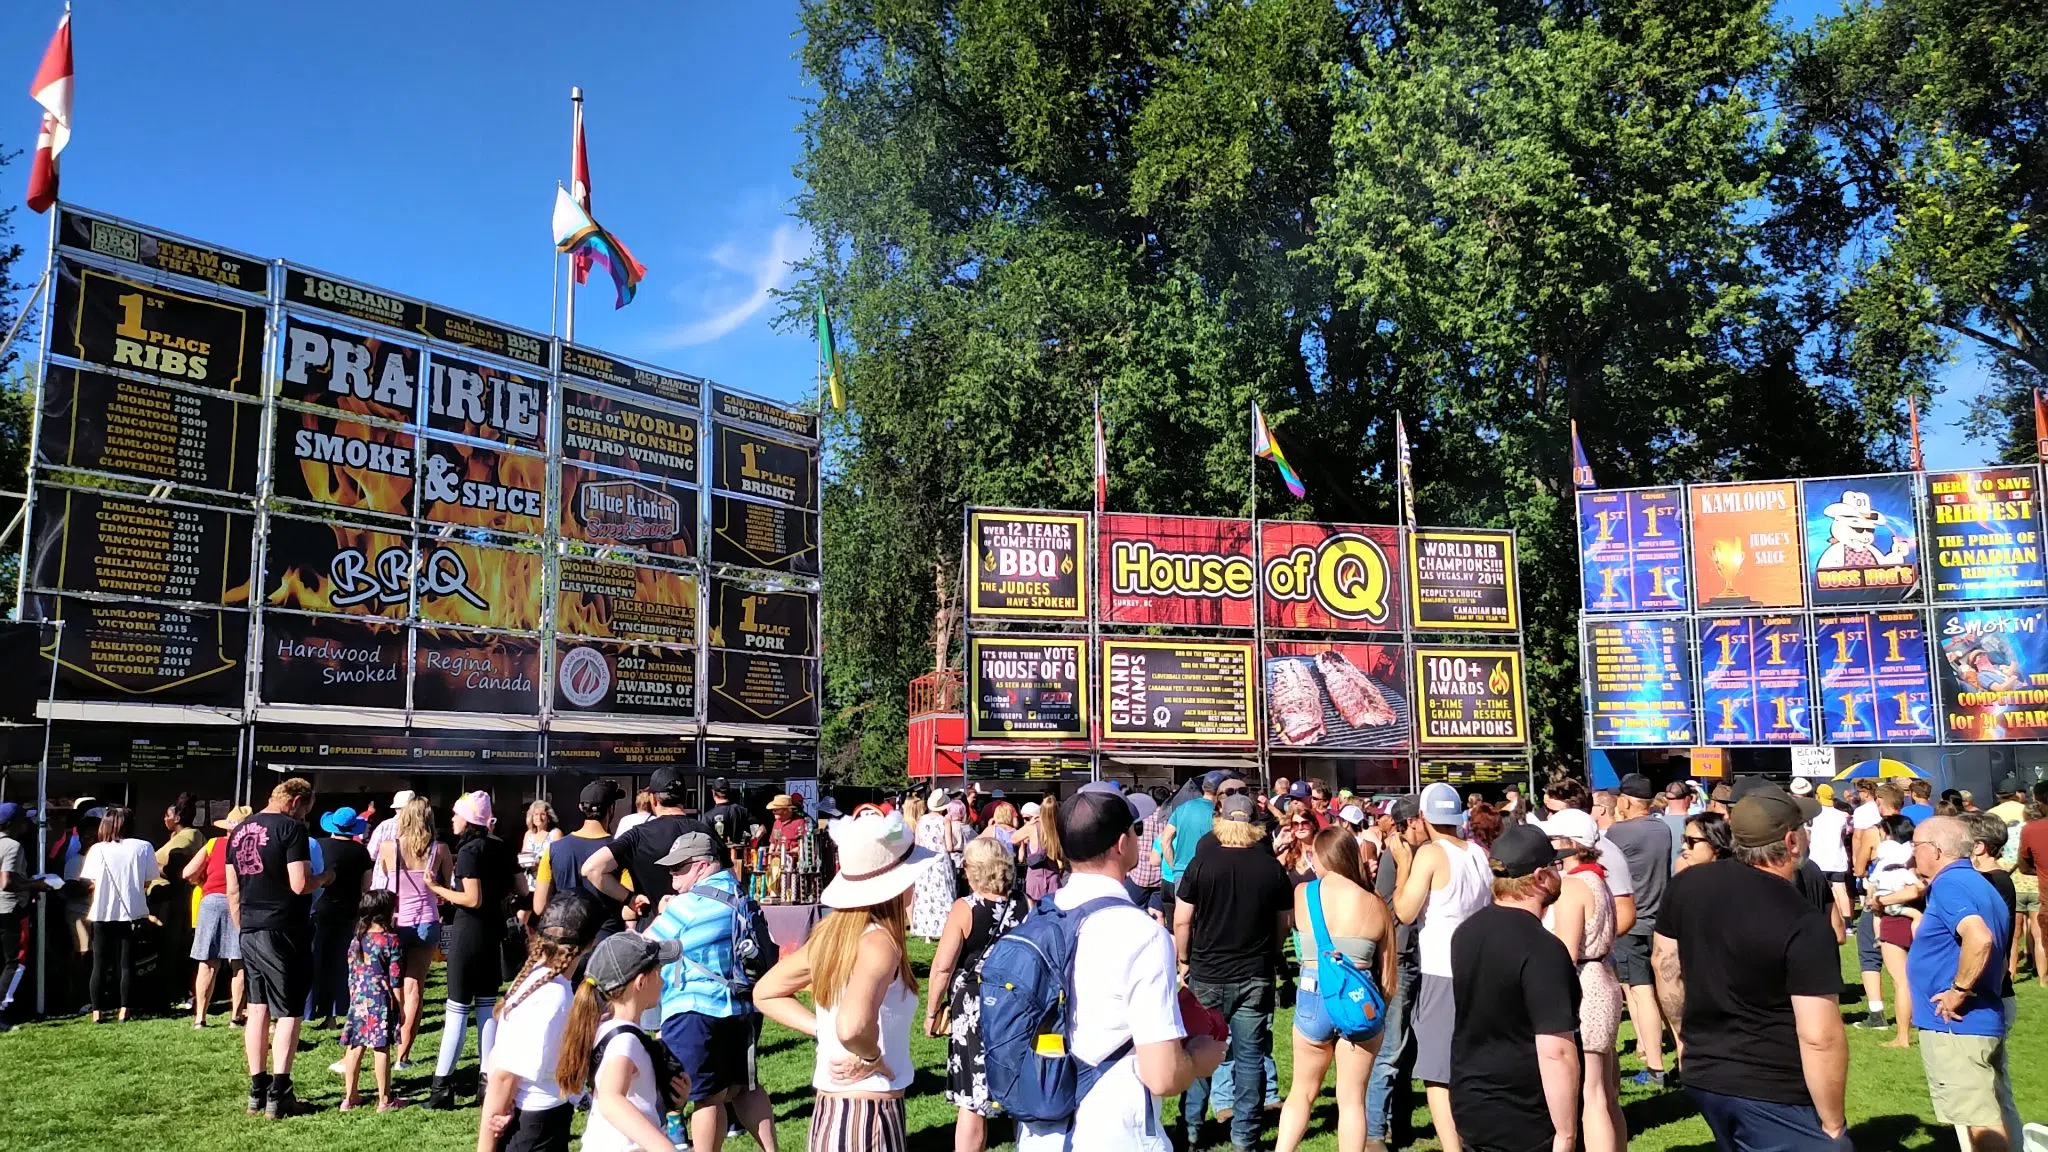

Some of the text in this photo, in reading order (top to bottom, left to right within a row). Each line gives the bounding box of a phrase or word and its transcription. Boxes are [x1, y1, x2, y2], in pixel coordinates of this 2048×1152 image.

[95, 229, 136, 251] BBQ
[157, 241, 241, 273] TEAM OF
[157, 255, 240, 285] THE YEAR
[304, 277, 404, 314] 18 GRAND
[117, 293, 164, 341] 1ST
[334, 298, 404, 321] CHAMPIONSHIPS
[445, 319, 502, 342] CANADA'S
[445, 328, 504, 350] WINNINGEST
[150, 331, 210, 355] PLACE
[507, 333, 540, 355] BBQ
[113, 339, 208, 380] RIBS
[507, 346, 539, 365] TEAM
[564, 351, 613, 373] 2-TIME
[285, 326, 540, 439] PRAIRIE
[564, 362, 631, 386] WORLD CHAMPS
[634, 369, 658, 384] JACK
[117, 393, 200, 416] MORDEN 2009
[118, 383, 201, 406] CALGARY 2009
[723, 395, 762, 413] CANADA
[108, 403, 207, 428] SASKATOON 2009
[566, 404, 694, 442] HOME OF WORLD
[107, 414, 207, 439] VANCOUVER 2011
[566, 418, 694, 456] CHAMPIONSHIP
[295, 430, 411, 476] SMOKE
[565, 434, 694, 471] AWARD WINNING
[741, 443, 767, 479] 1ST
[99, 457, 207, 482] CLOVERDALE 2013
[760, 470, 796, 488] PLACE
[1573, 466, 1594, 485] 01
[425, 454, 541, 516] & SPICE
[741, 479, 795, 501] BRISKET
[1932, 477, 2031, 494] HERE TO SAVE
[103, 501, 199, 522] KAMLOOPS 2013
[588, 488, 675, 521] Blue Ribbin'
[1702, 490, 1786, 513] KAMLOOPS
[1642, 504, 1674, 537] 1ST
[1935, 501, 2032, 524] RIBFEST
[586, 517, 673, 538] Sweet Sauce
[984, 522, 1070, 538] OVER 12 YEARS
[993, 536, 1072, 550] COMPETITION
[1750, 532, 1790, 548] JUDGE'S
[1936, 531, 2036, 548] THE PRIDE OF
[1424, 543, 1496, 558] WORLD RIB
[1755, 551, 1786, 564] SAUCE
[1939, 547, 2037, 567] CANADIAN
[560, 561, 635, 580] WORLD FOOD
[999, 549, 1056, 577] BBQ
[1419, 557, 1503, 572] CHAMPIONS!!!
[562, 572, 636, 588] CHAMPIONSHIPS
[1115, 536, 1387, 620] House of Q
[1817, 565, 1913, 588] BOSS HOG'S
[981, 581, 1050, 594] THE JUDGES
[1421, 589, 1482, 598] PEOPLE'S CHOICE
[613, 599, 695, 619] JACK DANIELS
[1007, 597, 1075, 608] HAVE SPOKEN!
[1453, 606, 1506, 615] CANADIAN BBQ
[739, 596, 768, 632] 1ST
[1943, 613, 2041, 636] Smokin'
[759, 624, 790, 637] PLACE
[278, 639, 381, 663] Hardwood
[745, 634, 785, 650] PORK
[1765, 631, 1799, 664] 1ST
[1882, 627, 1918, 662] 1ST
[982, 651, 996, 659] IT'S
[1044, 647, 1075, 660] VOTE
[323, 664, 397, 685] Smoked
[427, 652, 499, 677] Regina,
[617, 657, 692, 674] 2017 NATIONAL
[982, 660, 1076, 680] HOUSE OF Q
[1428, 658, 1481, 681] 100+
[466, 672, 531, 692] Canada
[616, 680, 692, 695] AWARDS OF
[617, 671, 693, 683] BBQ ASSOCIATION
[1112, 654, 1130, 725] GRAND
[1131, 655, 1146, 726] CHAMPS
[1429, 682, 1485, 695] AWARDS
[616, 694, 692, 708] EXCELLENCE
[1429, 699, 1463, 708] 8-TIME
[1475, 700, 1508, 709] 4-TIME
[1431, 710, 1462, 719] GRAND
[1473, 710, 1512, 719] RESERVE
[1949, 713, 1997, 730] for 20
[1431, 721, 1513, 735] CHAMPIONS
[256, 745, 314, 754] FOLLOW US!
[653, 747, 687, 755] LARGEST
[1797, 747, 1831, 757] BEANS
[1800, 758, 1831, 766] SLAW
